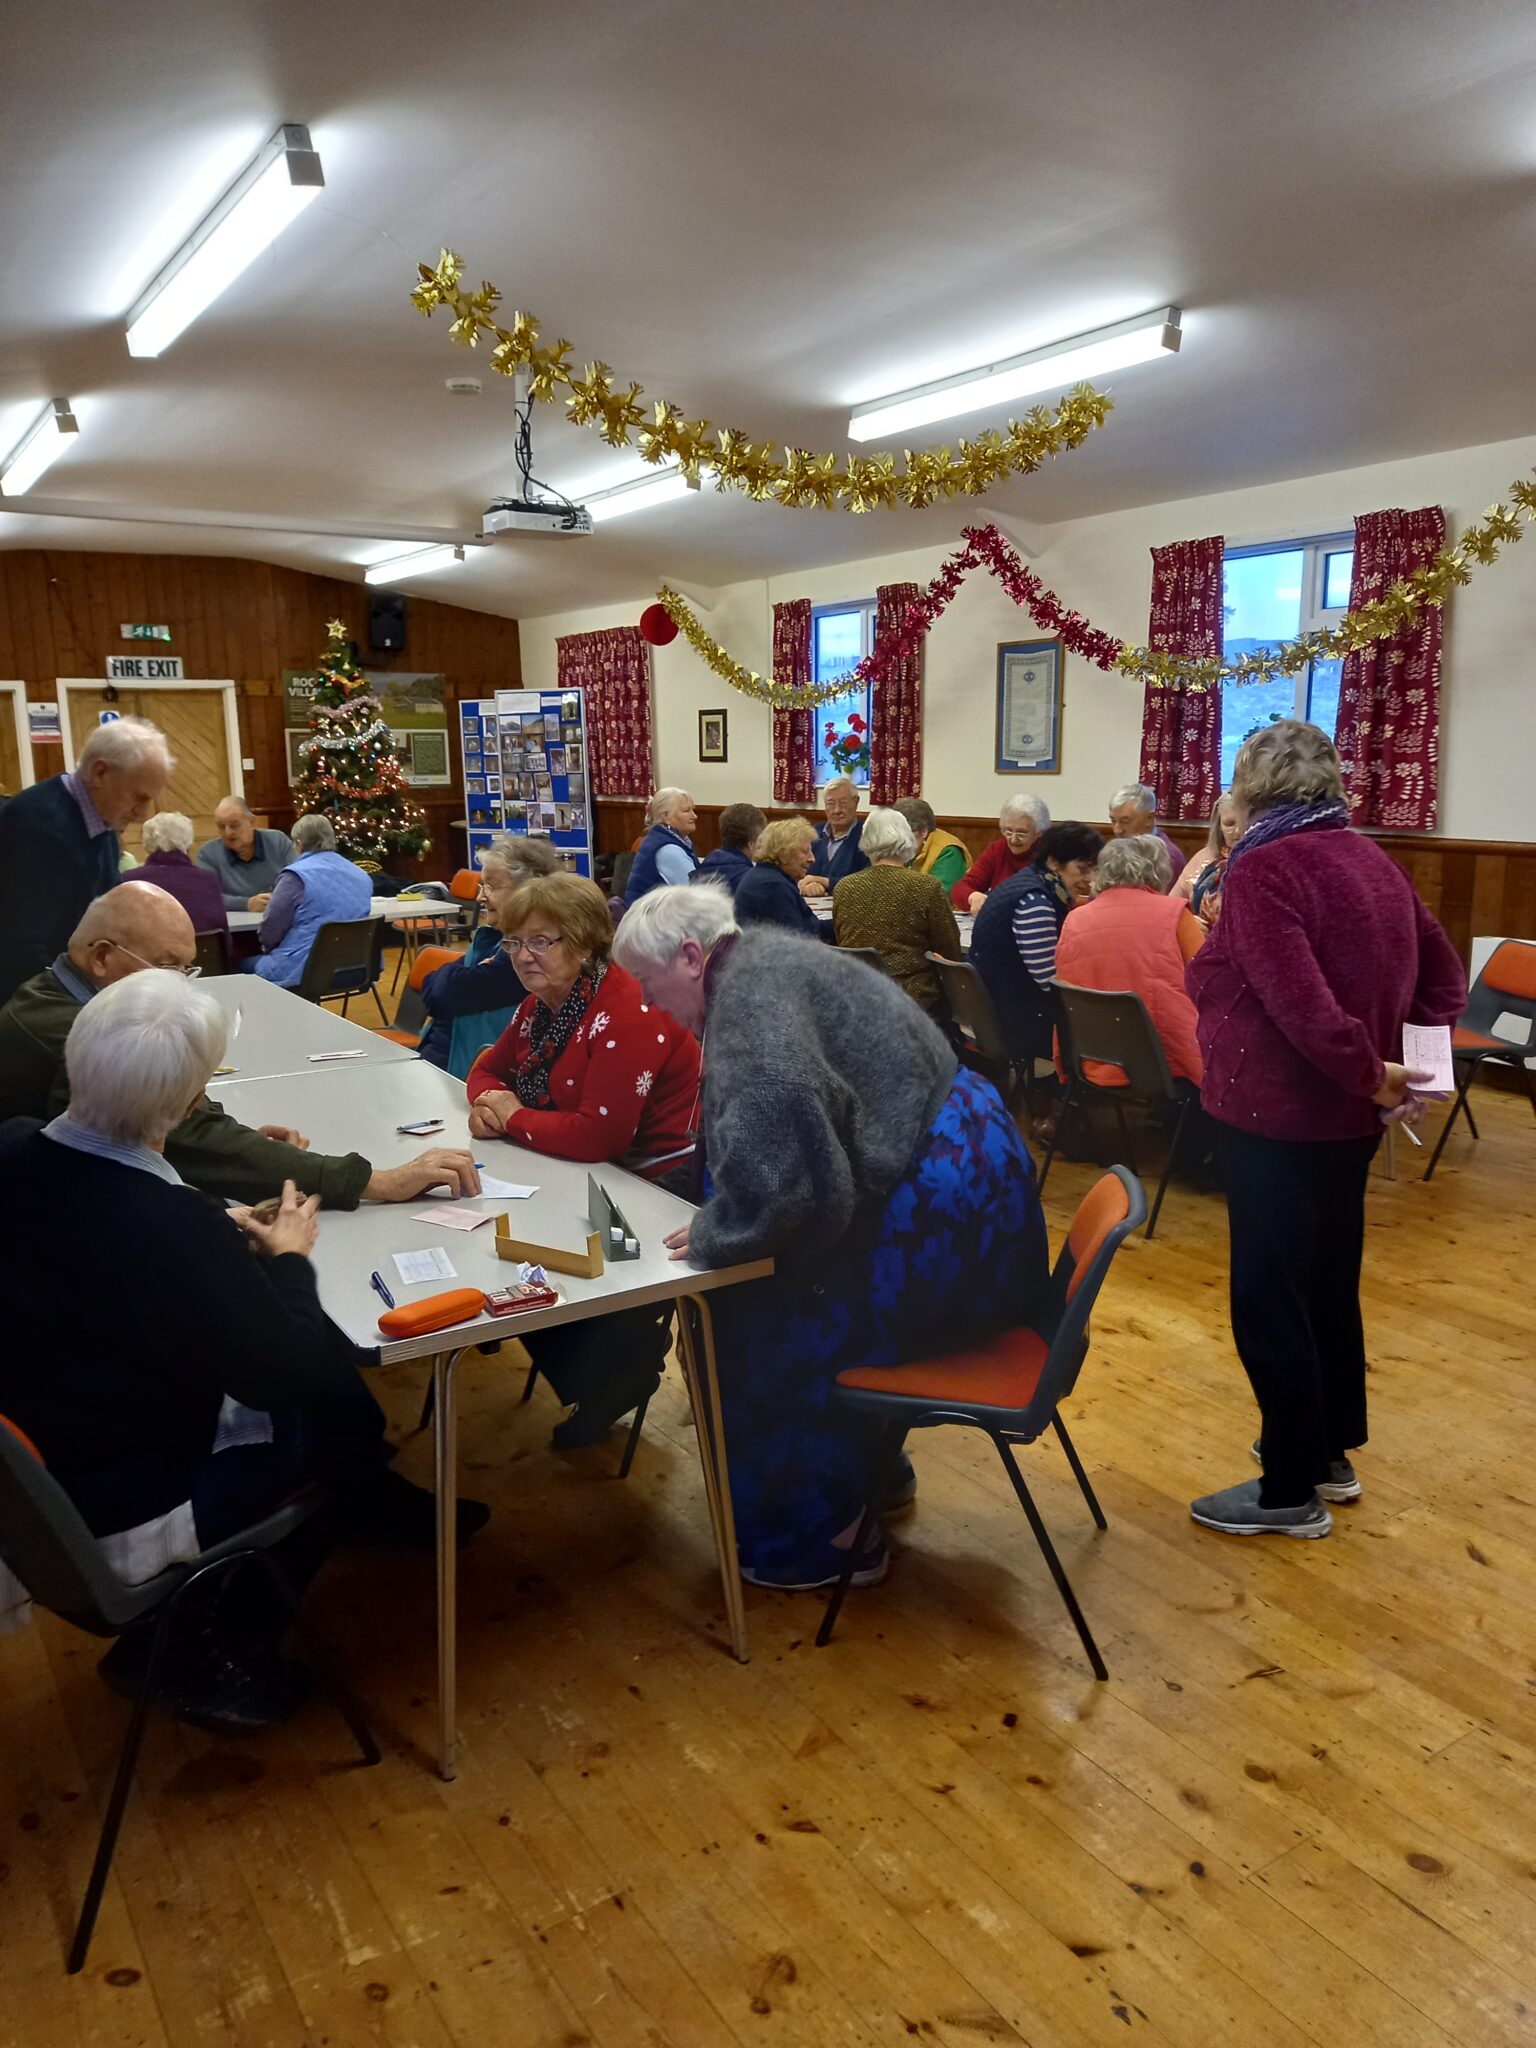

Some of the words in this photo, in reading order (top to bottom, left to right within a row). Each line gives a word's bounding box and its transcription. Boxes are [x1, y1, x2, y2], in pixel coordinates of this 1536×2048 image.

[112, 659, 143, 677] FIRE
[147, 660, 178, 677] EXIT
[292, 677, 316, 687] ROC
